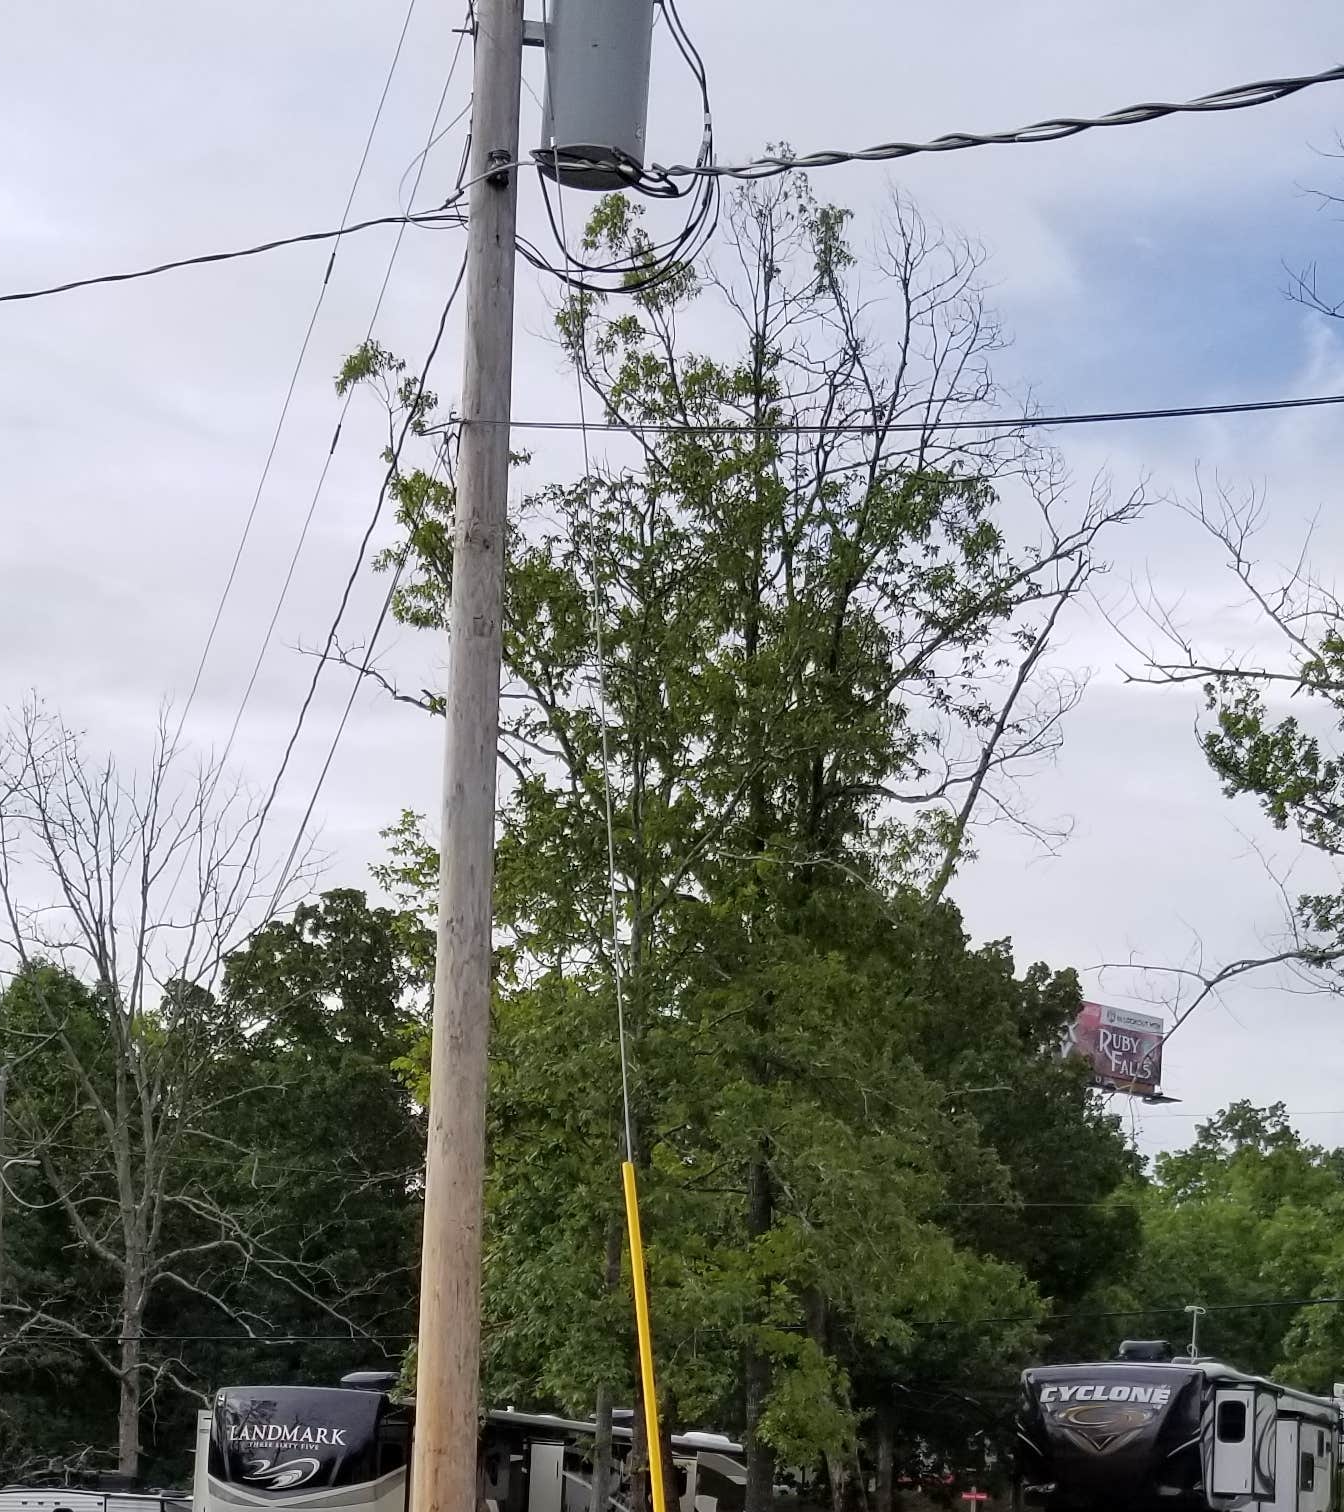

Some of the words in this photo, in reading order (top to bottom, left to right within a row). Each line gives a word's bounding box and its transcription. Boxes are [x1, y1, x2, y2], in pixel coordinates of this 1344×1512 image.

[1097, 1029, 1140, 1060] RUBY
[1111, 1051, 1152, 1079] FALLS
[1040, 1385, 1171, 1405] CYCLONE
[230, 1425, 347, 1446] LANDMARK
